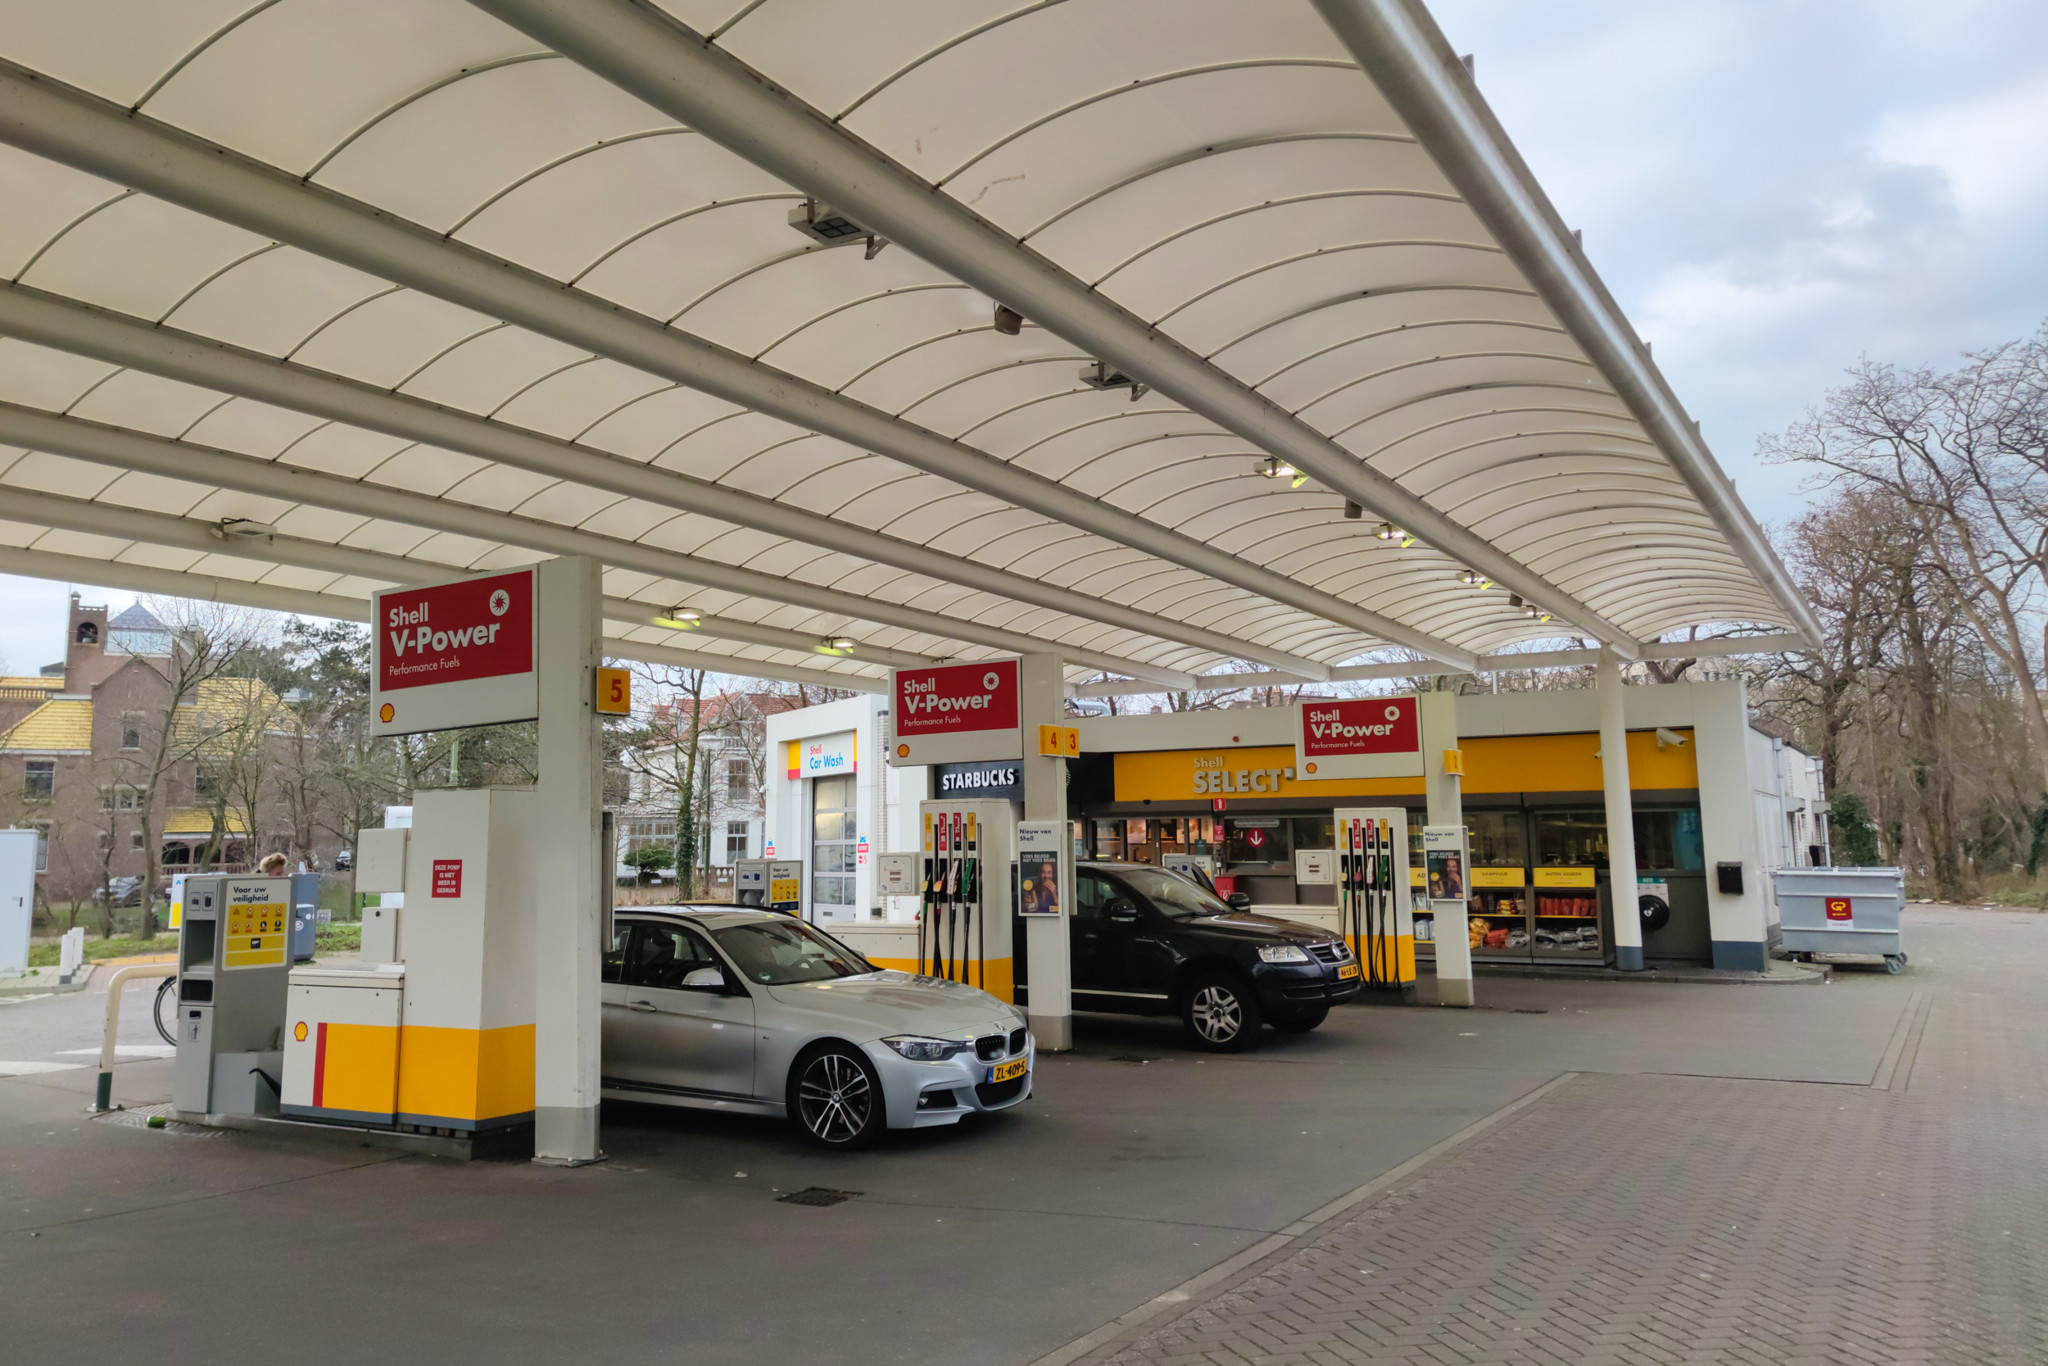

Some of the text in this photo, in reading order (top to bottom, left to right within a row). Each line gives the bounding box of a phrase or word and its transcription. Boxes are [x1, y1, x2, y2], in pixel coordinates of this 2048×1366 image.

[389, 602, 429, 628] Shell
[390, 623, 500, 657] V-Power
[389, 655, 460, 676] Performance Fuels
[610, 678, 623, 703] 5
[904, 678, 936, 694] Shell
[904, 694, 993, 714] V-Power
[904, 715, 961, 727] Performance Fuels
[1310, 709, 1340, 722] Shell
[1310, 723, 1394, 739] V-Power
[1050, 732, 1057, 749] 4
[1069, 733, 1076, 750] 3
[1311, 740, 1365, 749] Performance Fuels
[810, 744, 822, 755] Shell
[810, 752, 844, 770] Car Wash
[1193, 756, 1224, 768] Shell
[942, 768, 1015, 791] STARBUCKS
[1193, 769, 1282, 794] SELECT
[233, 894, 269, 903] veiligheid
[995, 1061, 1025, 1079] ZL-409-S
